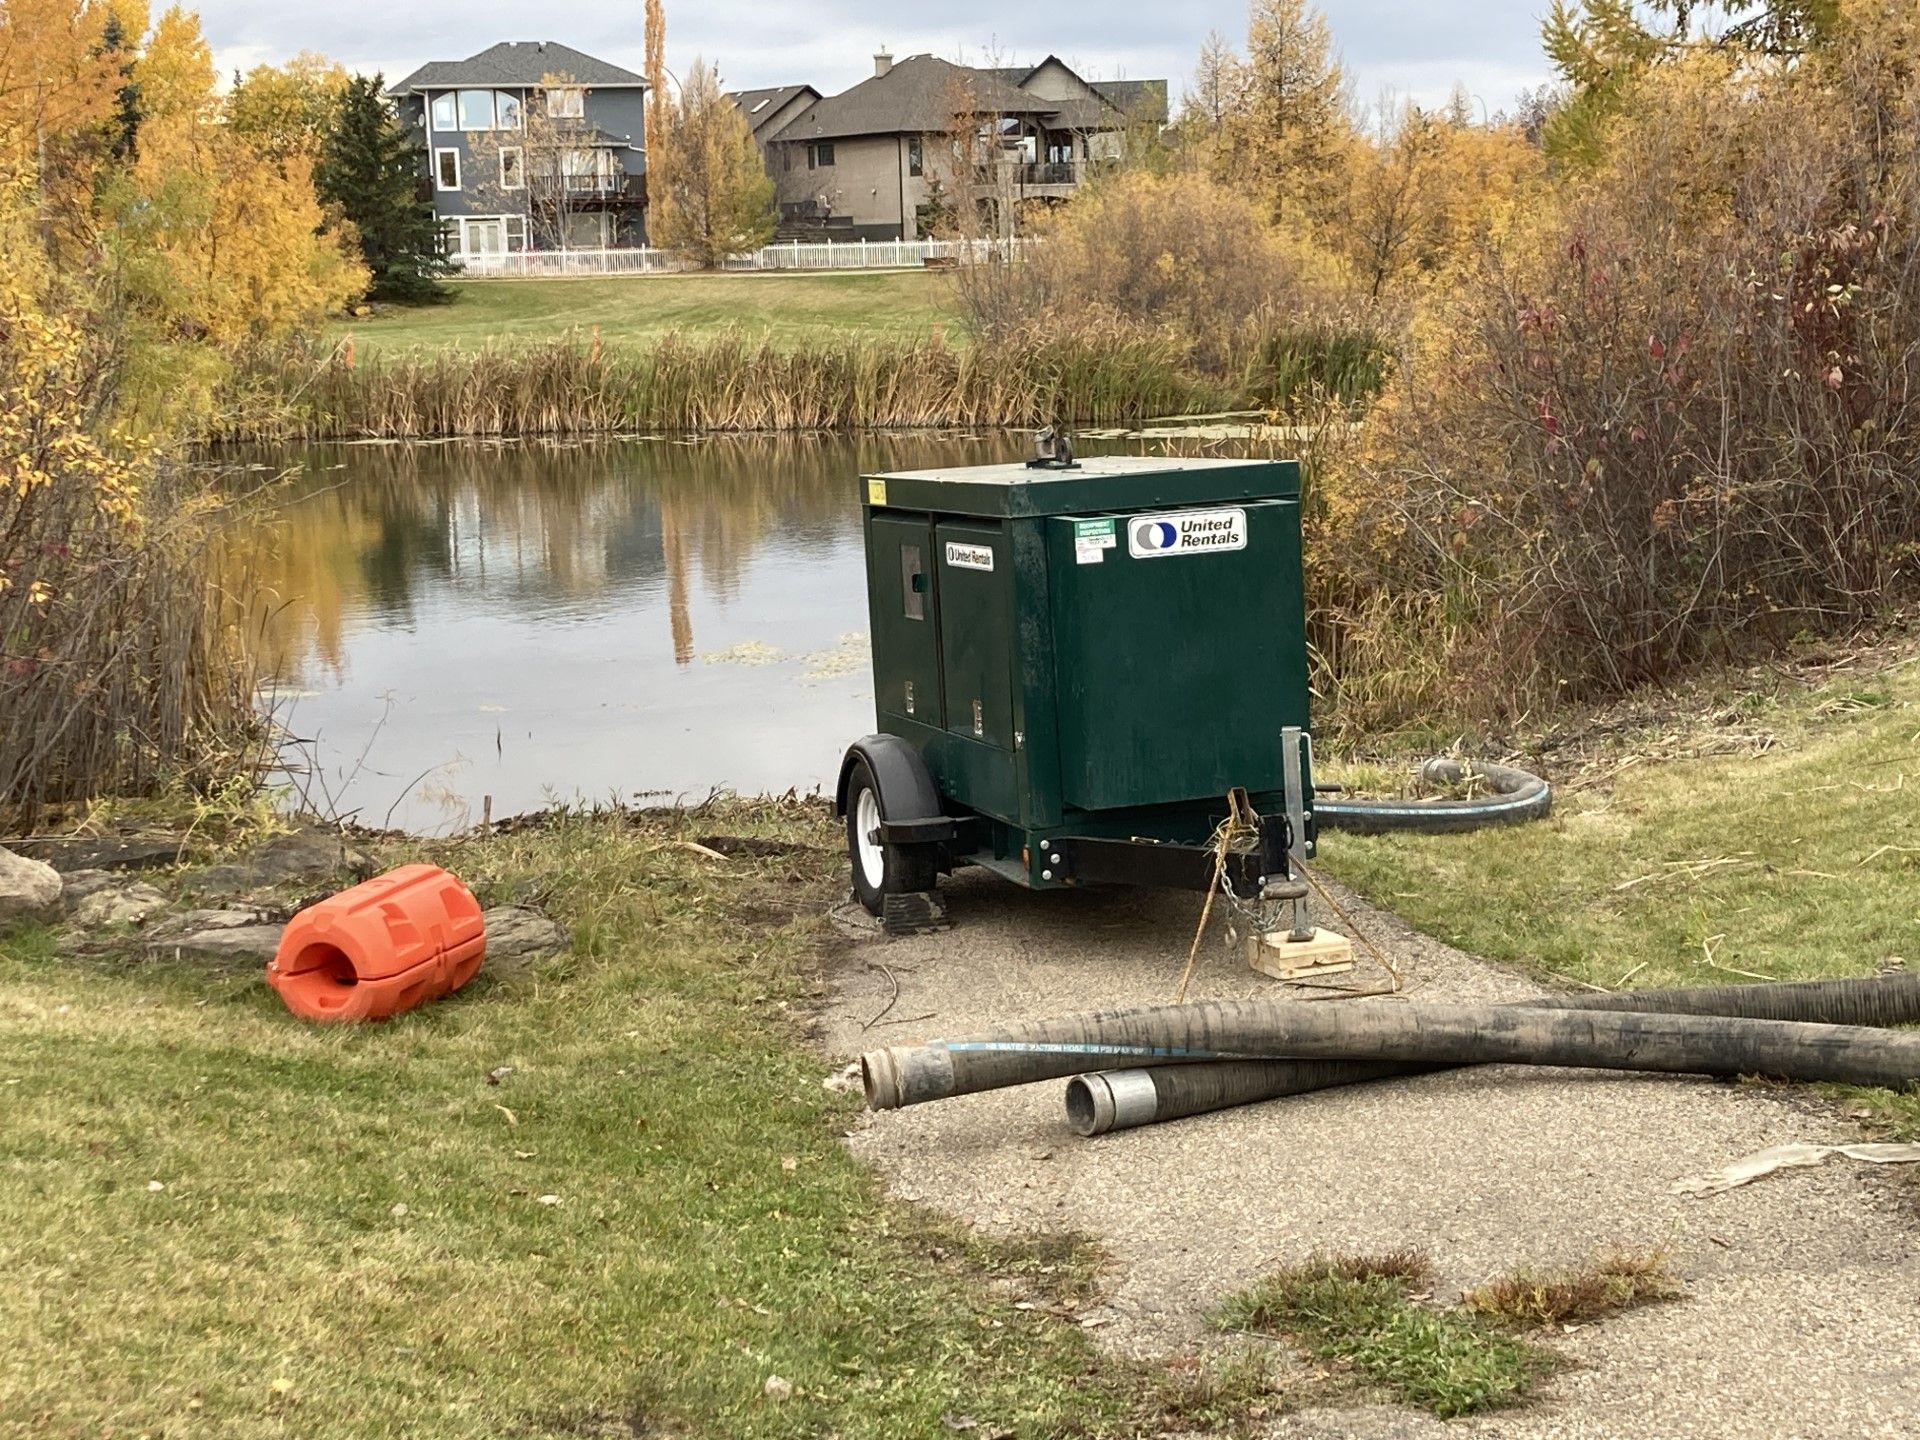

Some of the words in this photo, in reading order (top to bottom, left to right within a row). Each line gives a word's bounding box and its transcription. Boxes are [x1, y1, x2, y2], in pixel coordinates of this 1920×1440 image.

[1181, 517, 1233, 533] United
[1181, 532, 1239, 547] Rentals
[954, 548, 971, 562] United
[972, 550, 991, 565] Rentals
